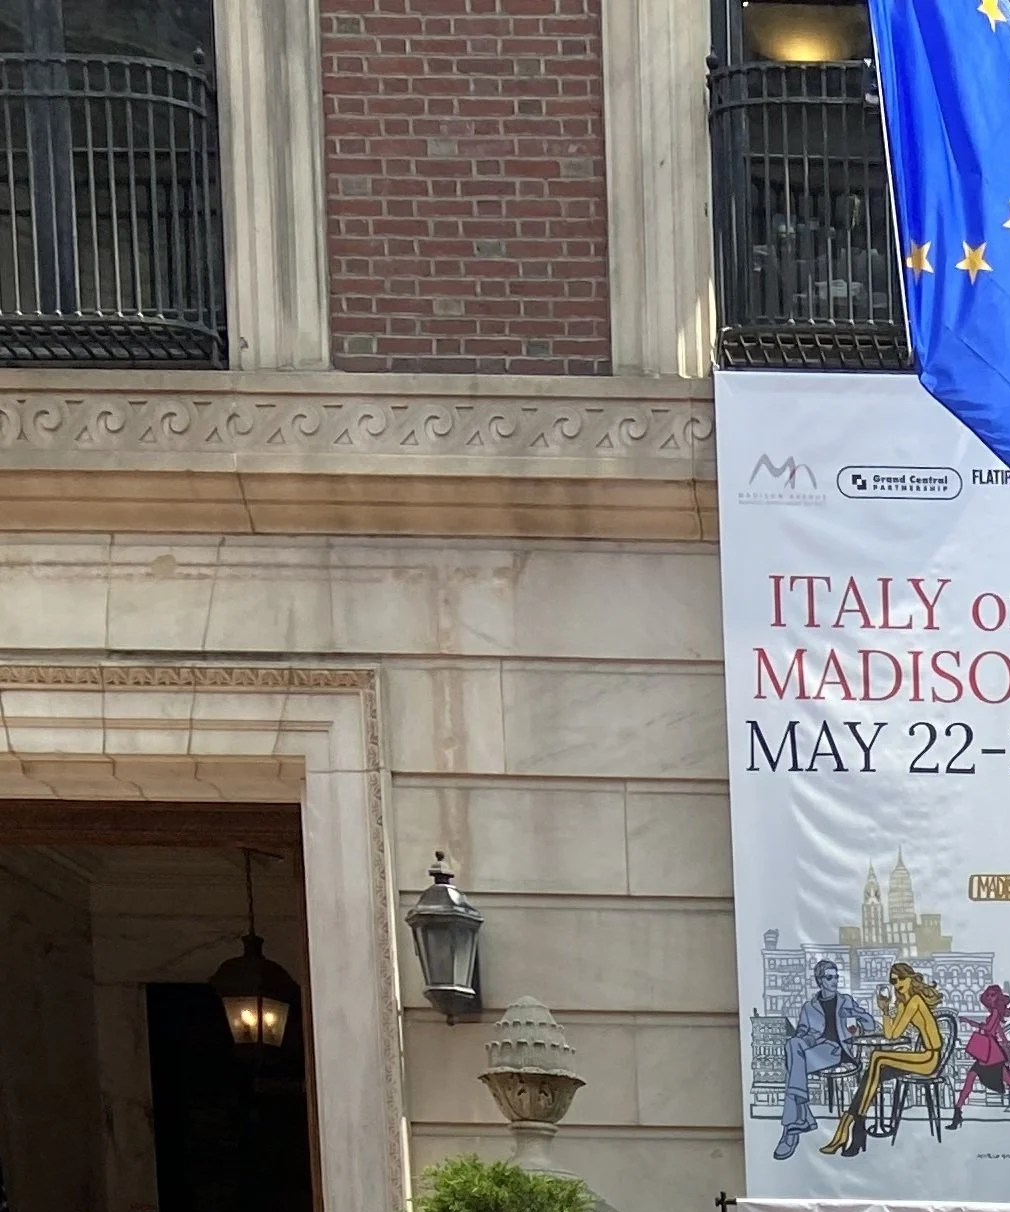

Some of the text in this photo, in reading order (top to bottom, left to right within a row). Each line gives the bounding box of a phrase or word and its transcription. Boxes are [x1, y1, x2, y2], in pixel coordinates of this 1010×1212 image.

[873, 475, 948, 485] Grand Central
[769, 575, 951, 631] ITALY
[745, 720, 888, 773] MAY
